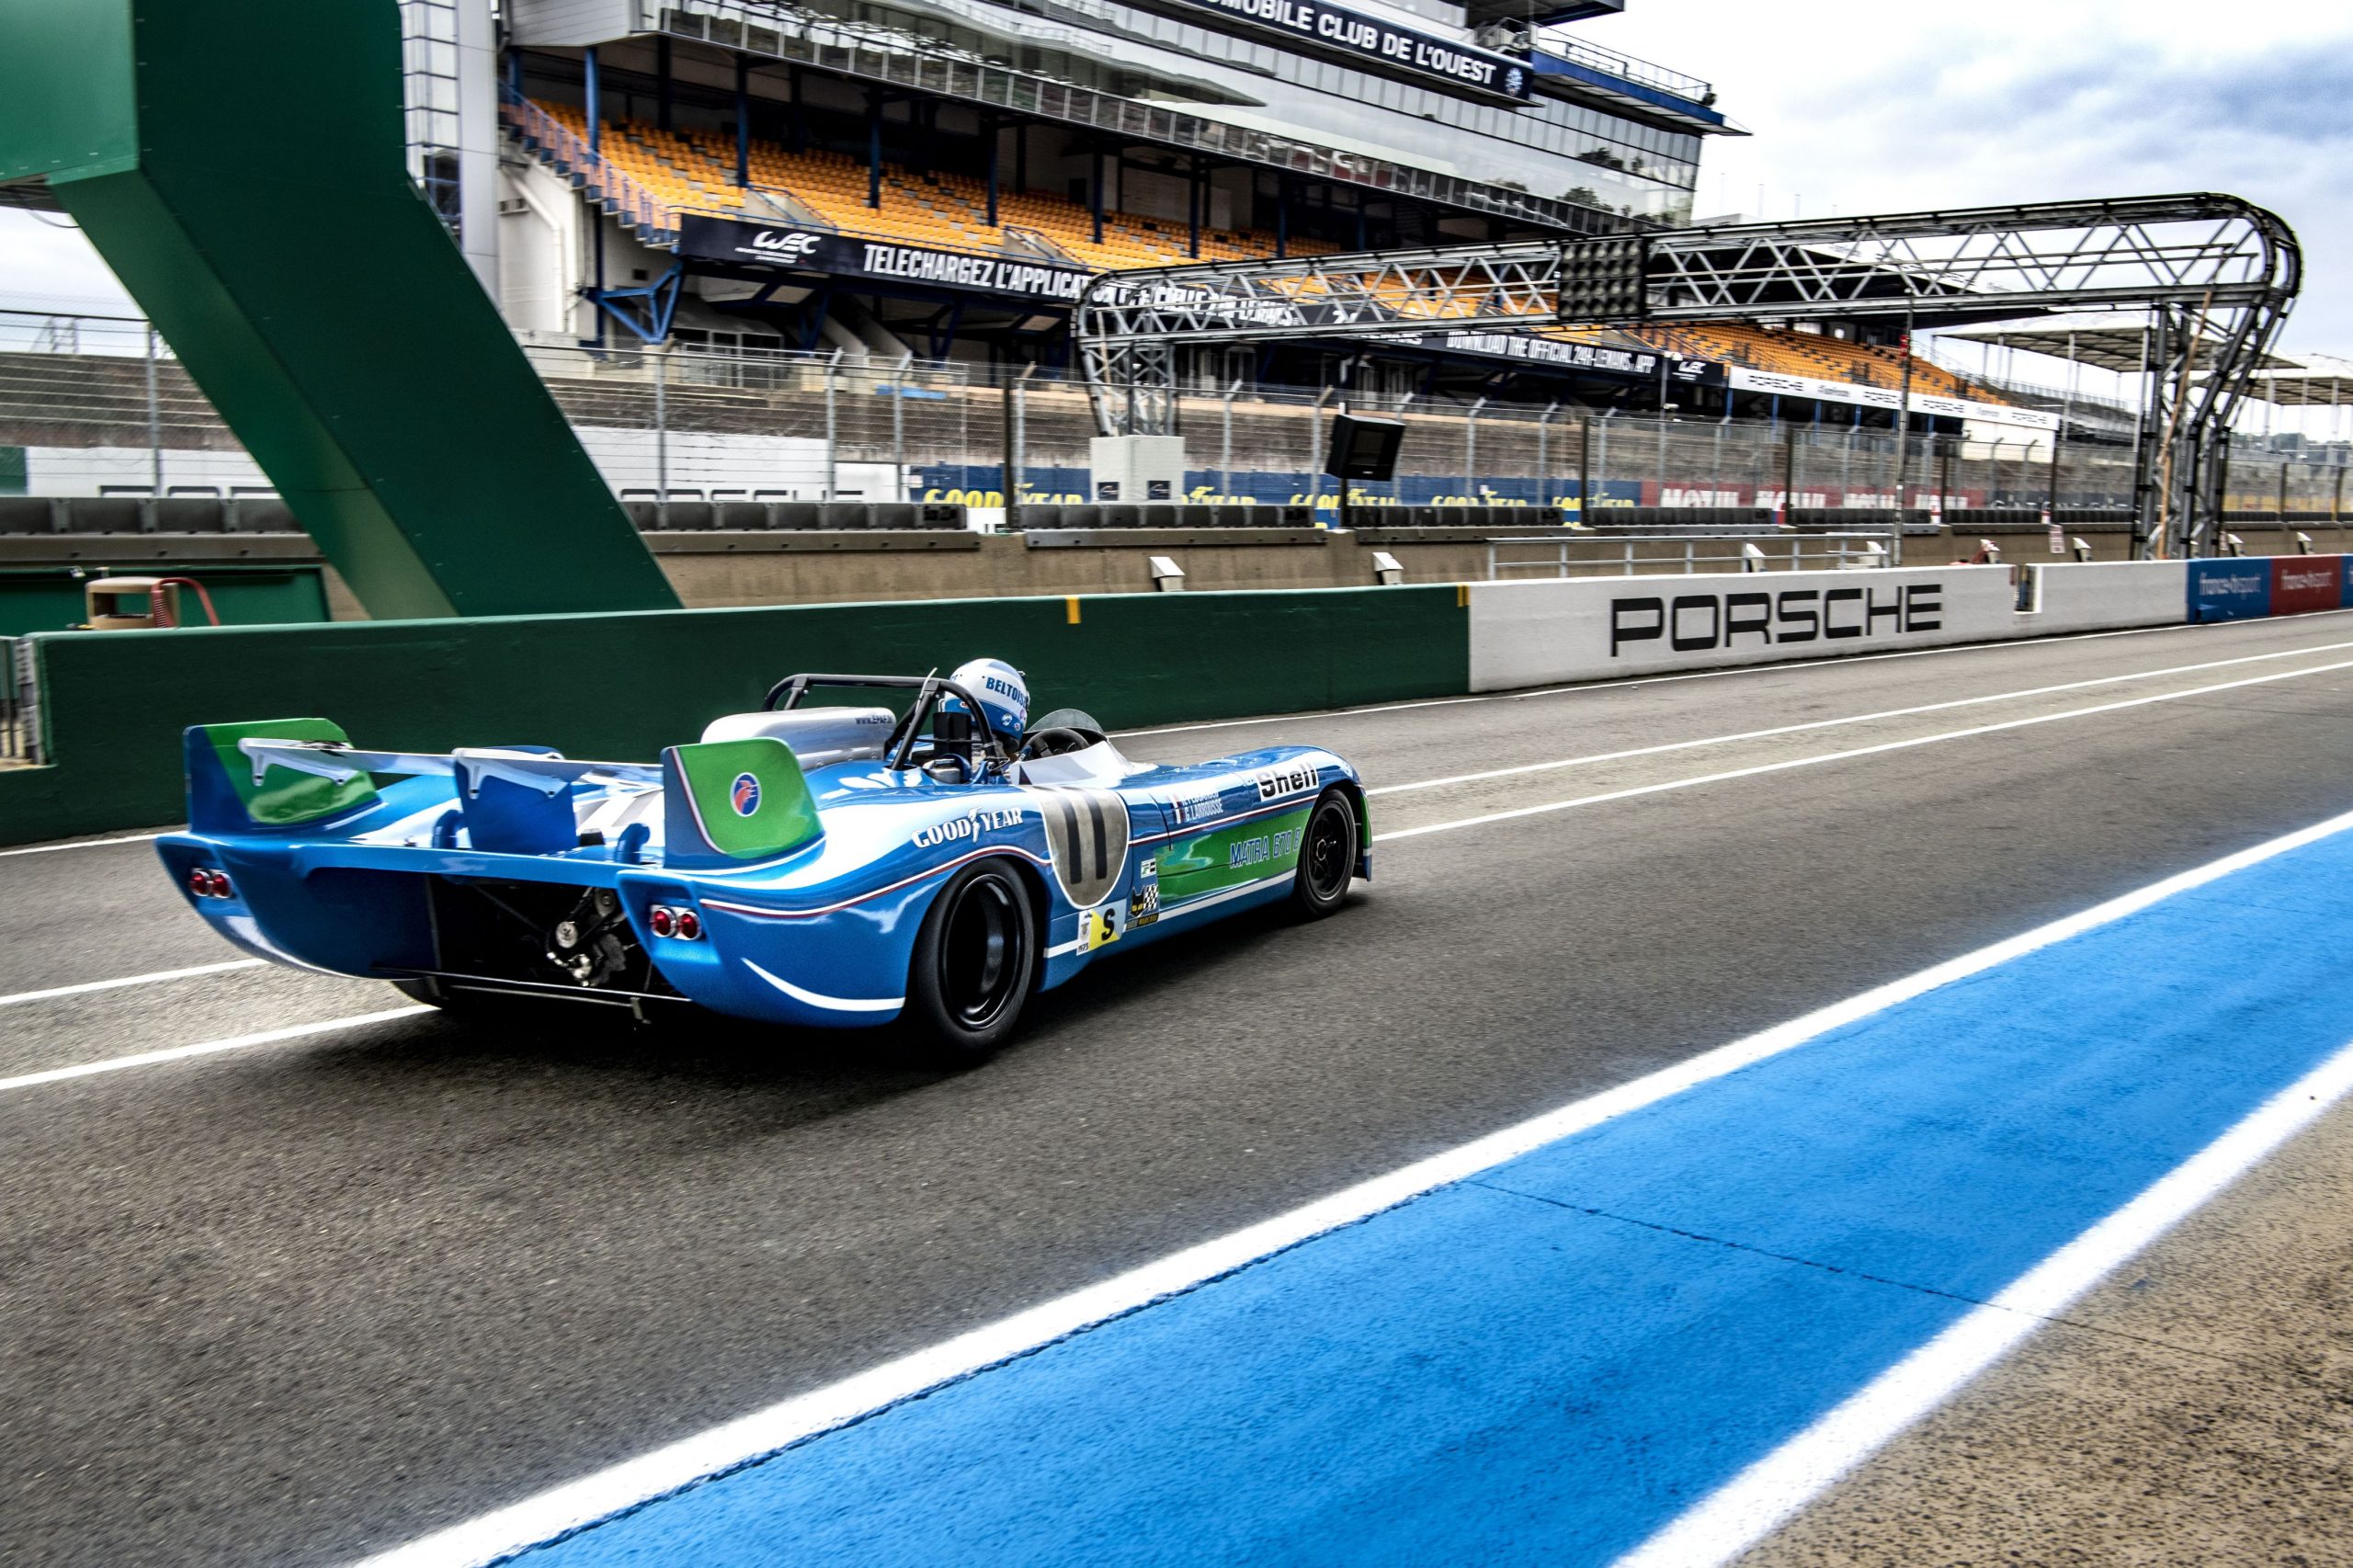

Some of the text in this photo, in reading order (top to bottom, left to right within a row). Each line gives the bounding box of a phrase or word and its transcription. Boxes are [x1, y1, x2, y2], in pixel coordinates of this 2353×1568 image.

[1205, 0, 1314, 31] OBILE
[1318, 13, 1378, 50] CLUB
[1381, 32, 1414, 61] DE
[1415, 42, 1497, 85] L'OUEST
[753, 231, 822, 255] WEC
[863, 244, 995, 287] TELECHARGEZ
[1507, 335, 1530, 358] THE
[1528, 339, 1573, 363] OFFICIAL
[1748, 375, 1804, 392] PORSCHE
[1609, 584, 1942, 657] PORSCHE
[1255, 761, 1317, 798] Shell
[1058, 790, 1108, 884] 11
[1230, 835, 1270, 869] MATRA
[1272, 829, 1293, 858] 670
[1101, 907, 1116, 941] S
